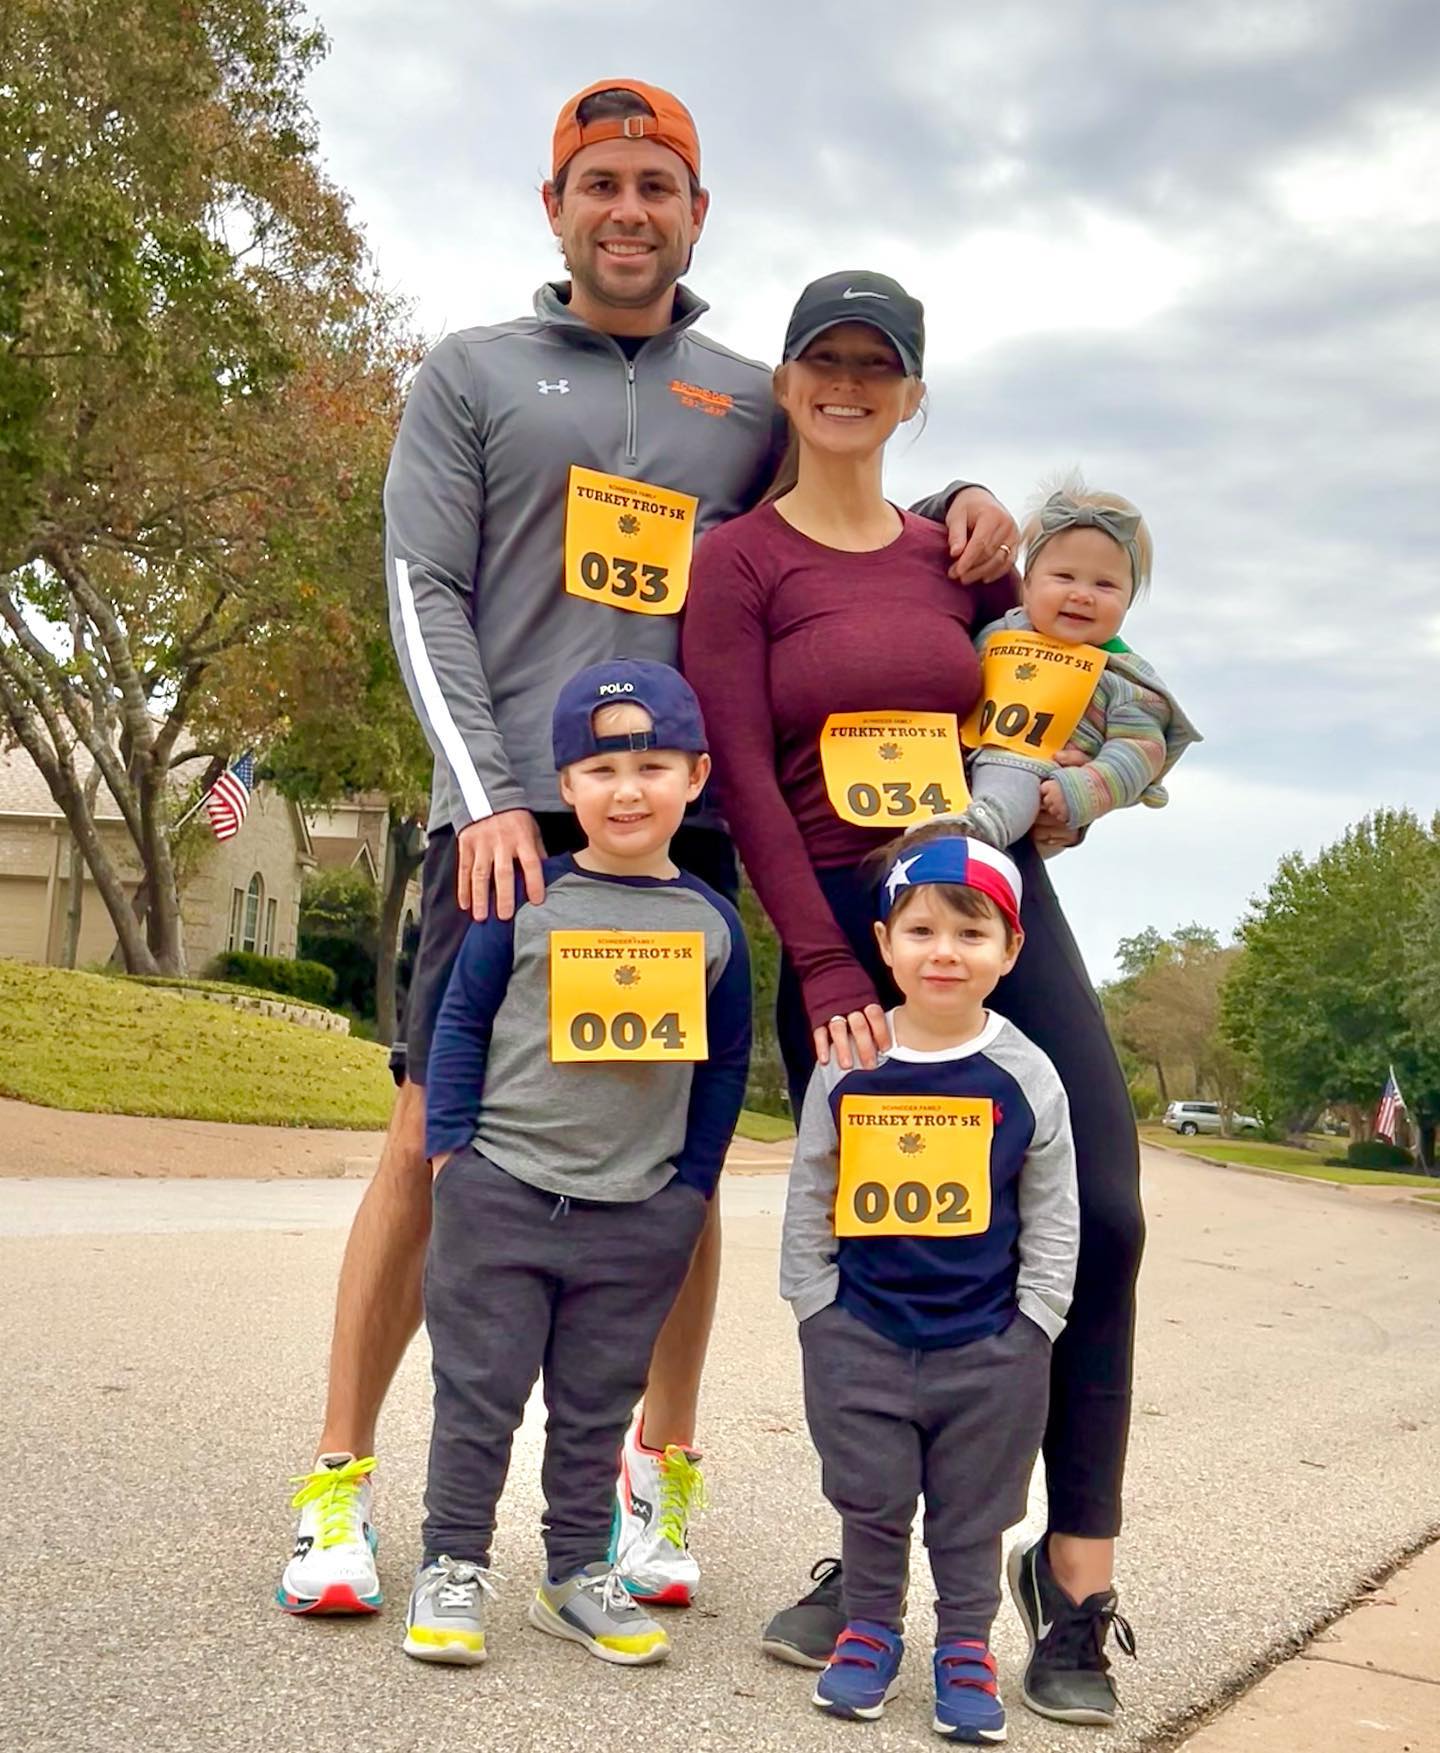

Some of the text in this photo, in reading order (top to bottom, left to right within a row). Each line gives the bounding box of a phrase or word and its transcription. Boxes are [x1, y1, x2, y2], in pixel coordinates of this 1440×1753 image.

[577, 486, 686, 520] TURKEY TROT 5K
[581, 551, 669, 603] 033
[988, 646, 1094, 672] TURKEY TROT 5K
[600, 683, 634, 695] POLO
[830, 727, 947, 738] TURKEY TROT 5K
[847, 782, 952, 817] 034
[560, 948, 693, 959] TURKEY TROT 5K
[570, 1012, 686, 1051] 004
[848, 1114, 981, 1127] TURKEY TROT 5K
[853, 1181, 972, 1224] 002
